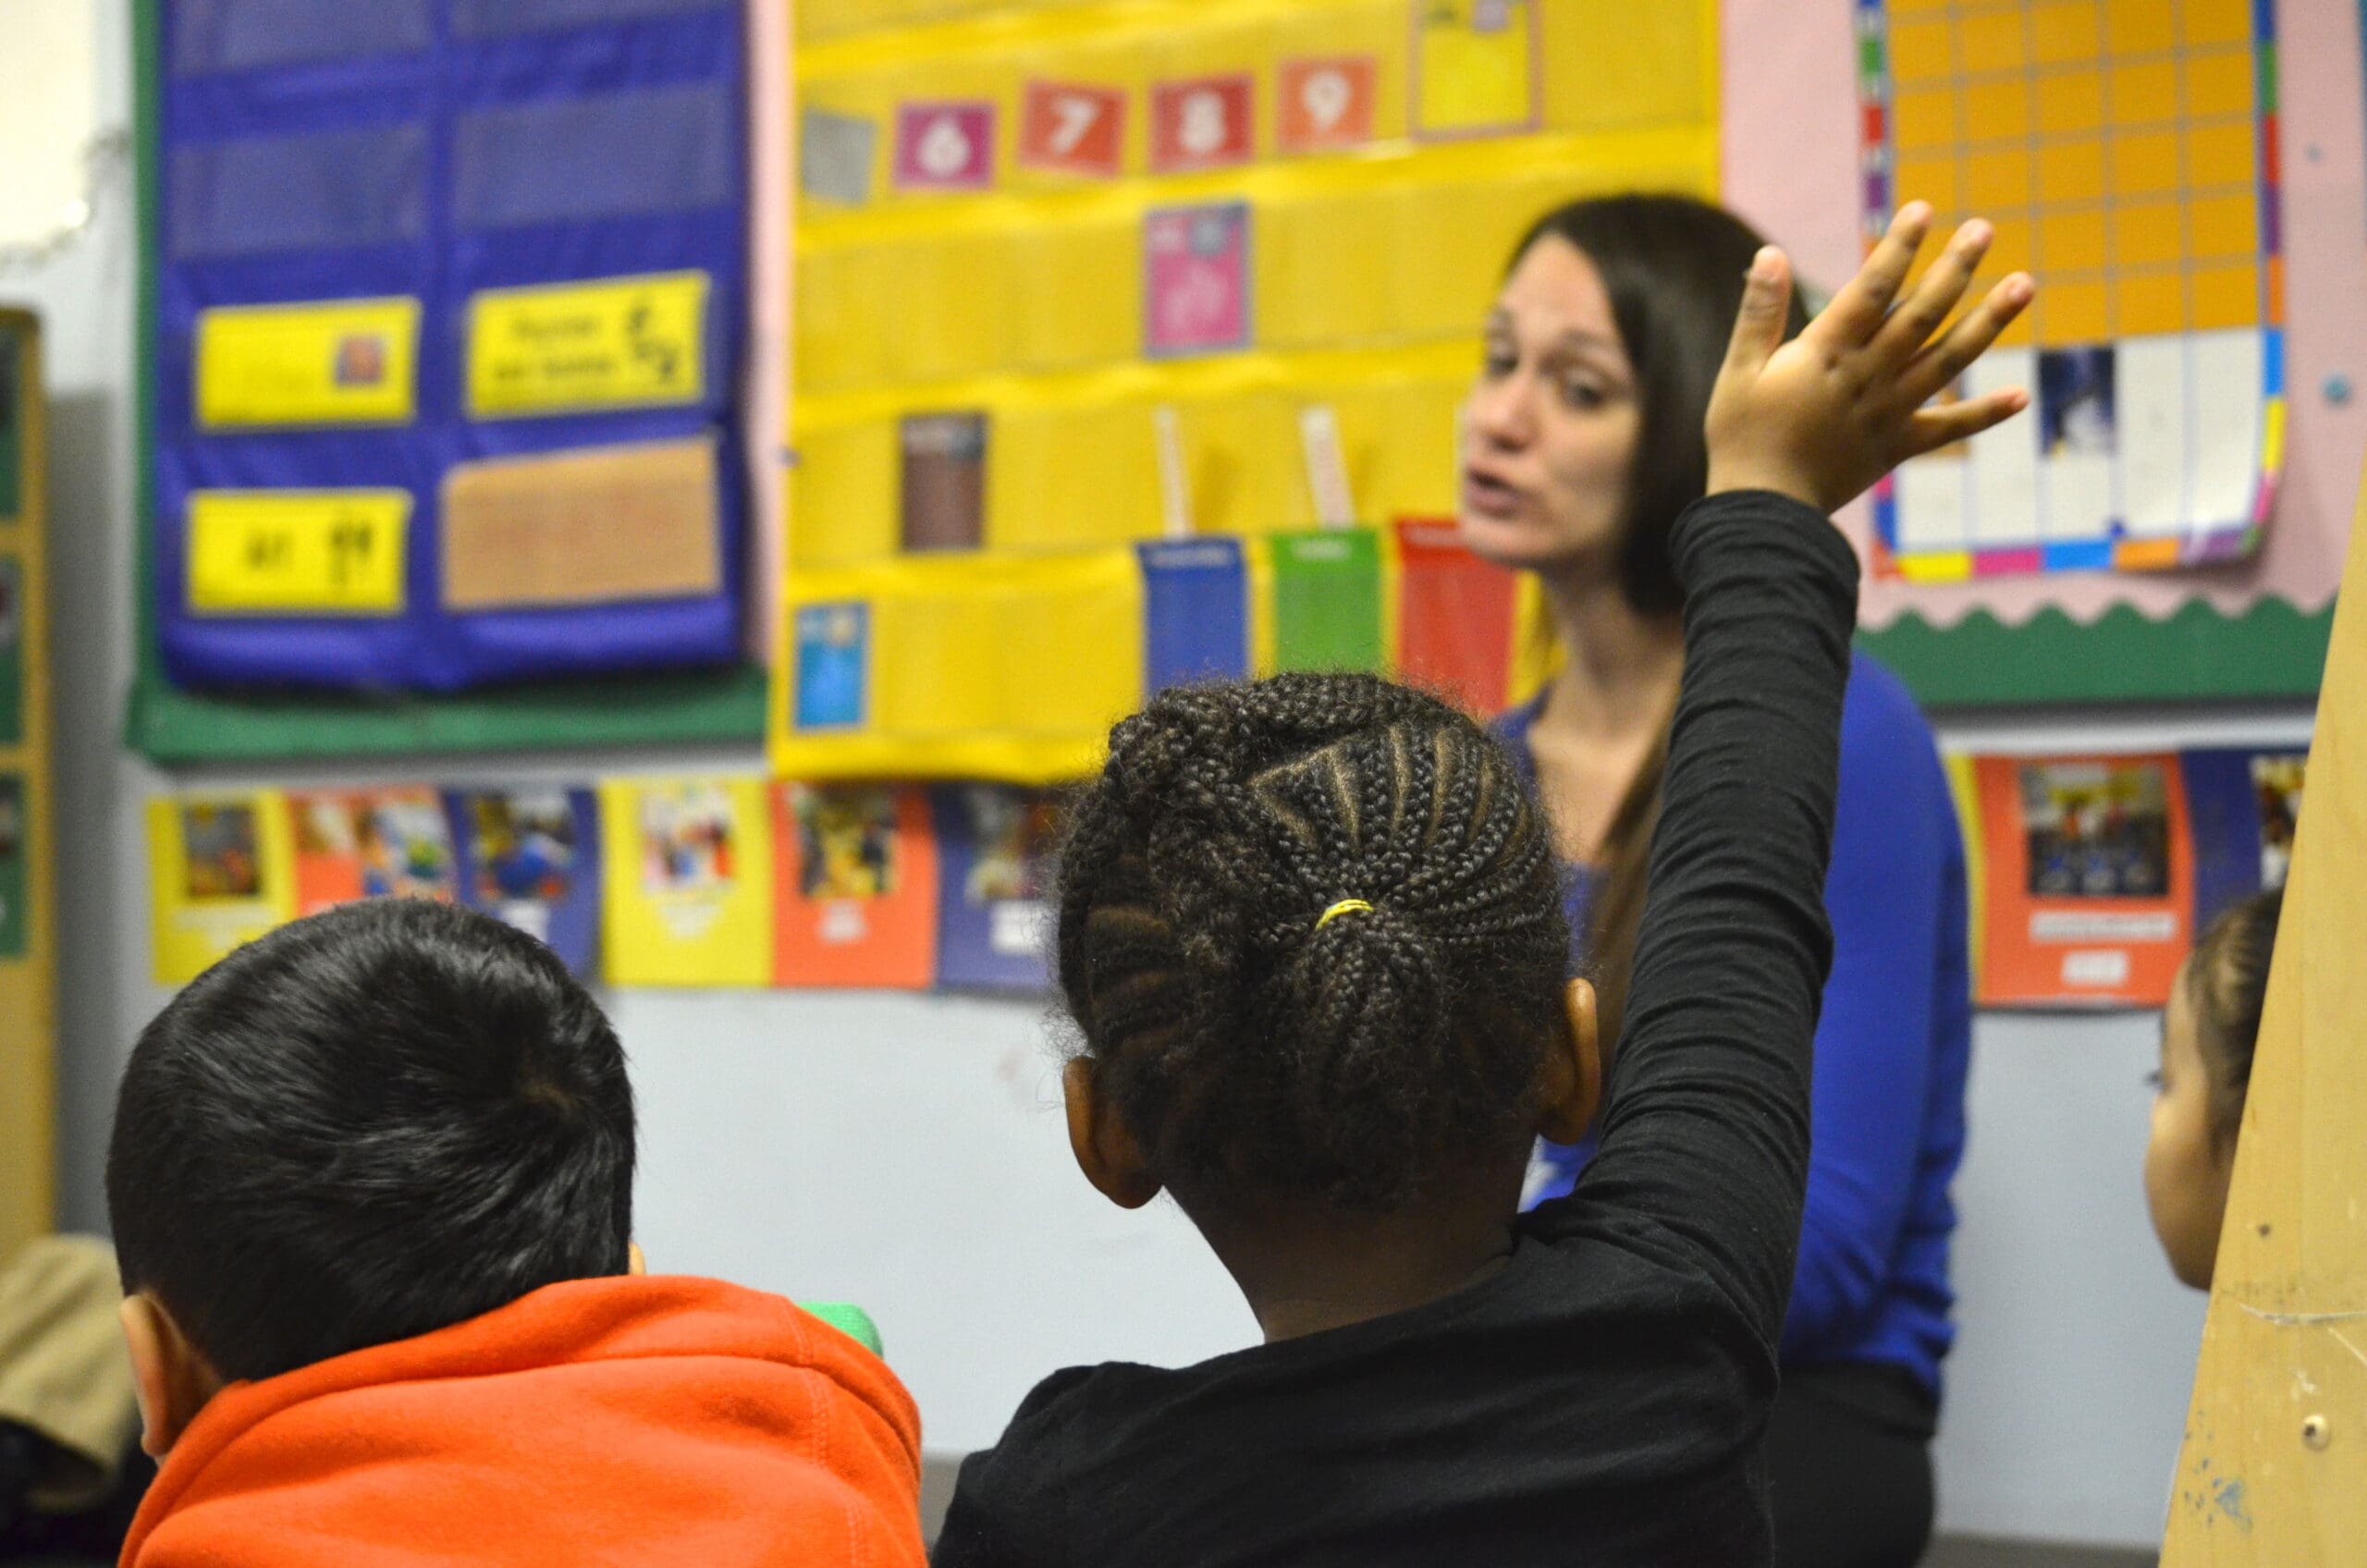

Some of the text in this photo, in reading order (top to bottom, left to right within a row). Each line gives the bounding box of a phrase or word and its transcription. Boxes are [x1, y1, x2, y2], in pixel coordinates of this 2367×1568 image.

[1049, 94, 1097, 153] 7
[1179, 91, 1225, 153] 8
[1304, 72, 1350, 133] 9
[919, 116, 971, 177] 6
